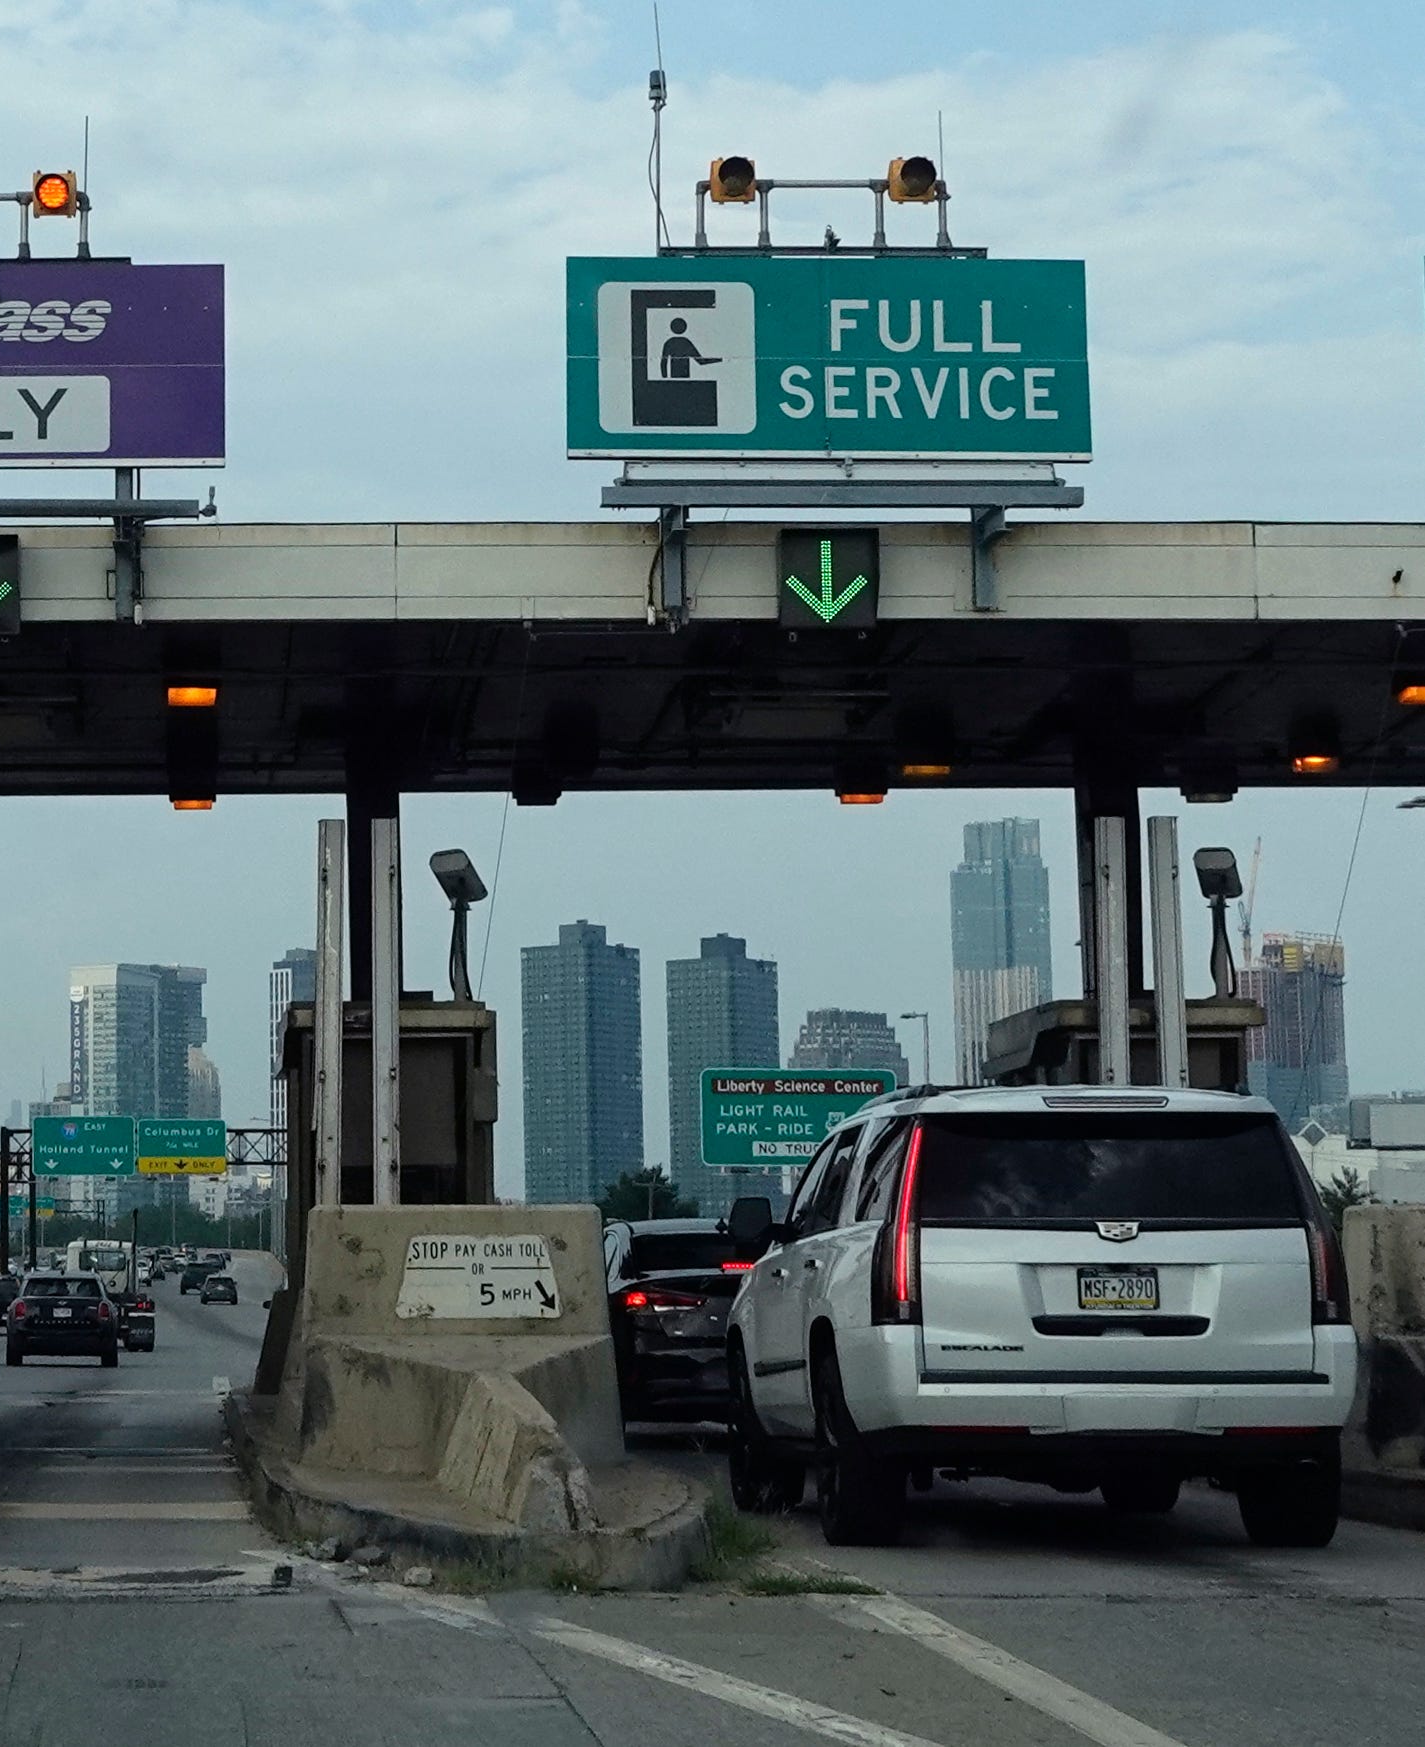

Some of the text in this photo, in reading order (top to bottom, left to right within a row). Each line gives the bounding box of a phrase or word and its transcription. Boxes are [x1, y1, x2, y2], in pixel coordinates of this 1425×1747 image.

[830, 299, 1022, 353] FULL
[778, 366, 1059, 420] SERVICE
[716, 1079, 879, 1095] Liberty Science Center
[720, 1104, 808, 1117] LIGHT RAIL
[84, 1122, 106, 1131] EAST
[144, 1126, 219, 1136] Columbus Dr
[716, 1123, 758, 1135] PARK
[778, 1123, 814, 1135] RIDE
[39, 1145, 129, 1154] Holland Tunnel
[758, 1143, 776, 1154] NO
[149, 1161, 216, 1169] EXIT ONLY
[411, 1242, 545, 1259] STOP PAY CASH TOLL
[471, 1263, 485, 1275] OR
[480, 1283, 532, 1306] 5 MPH
